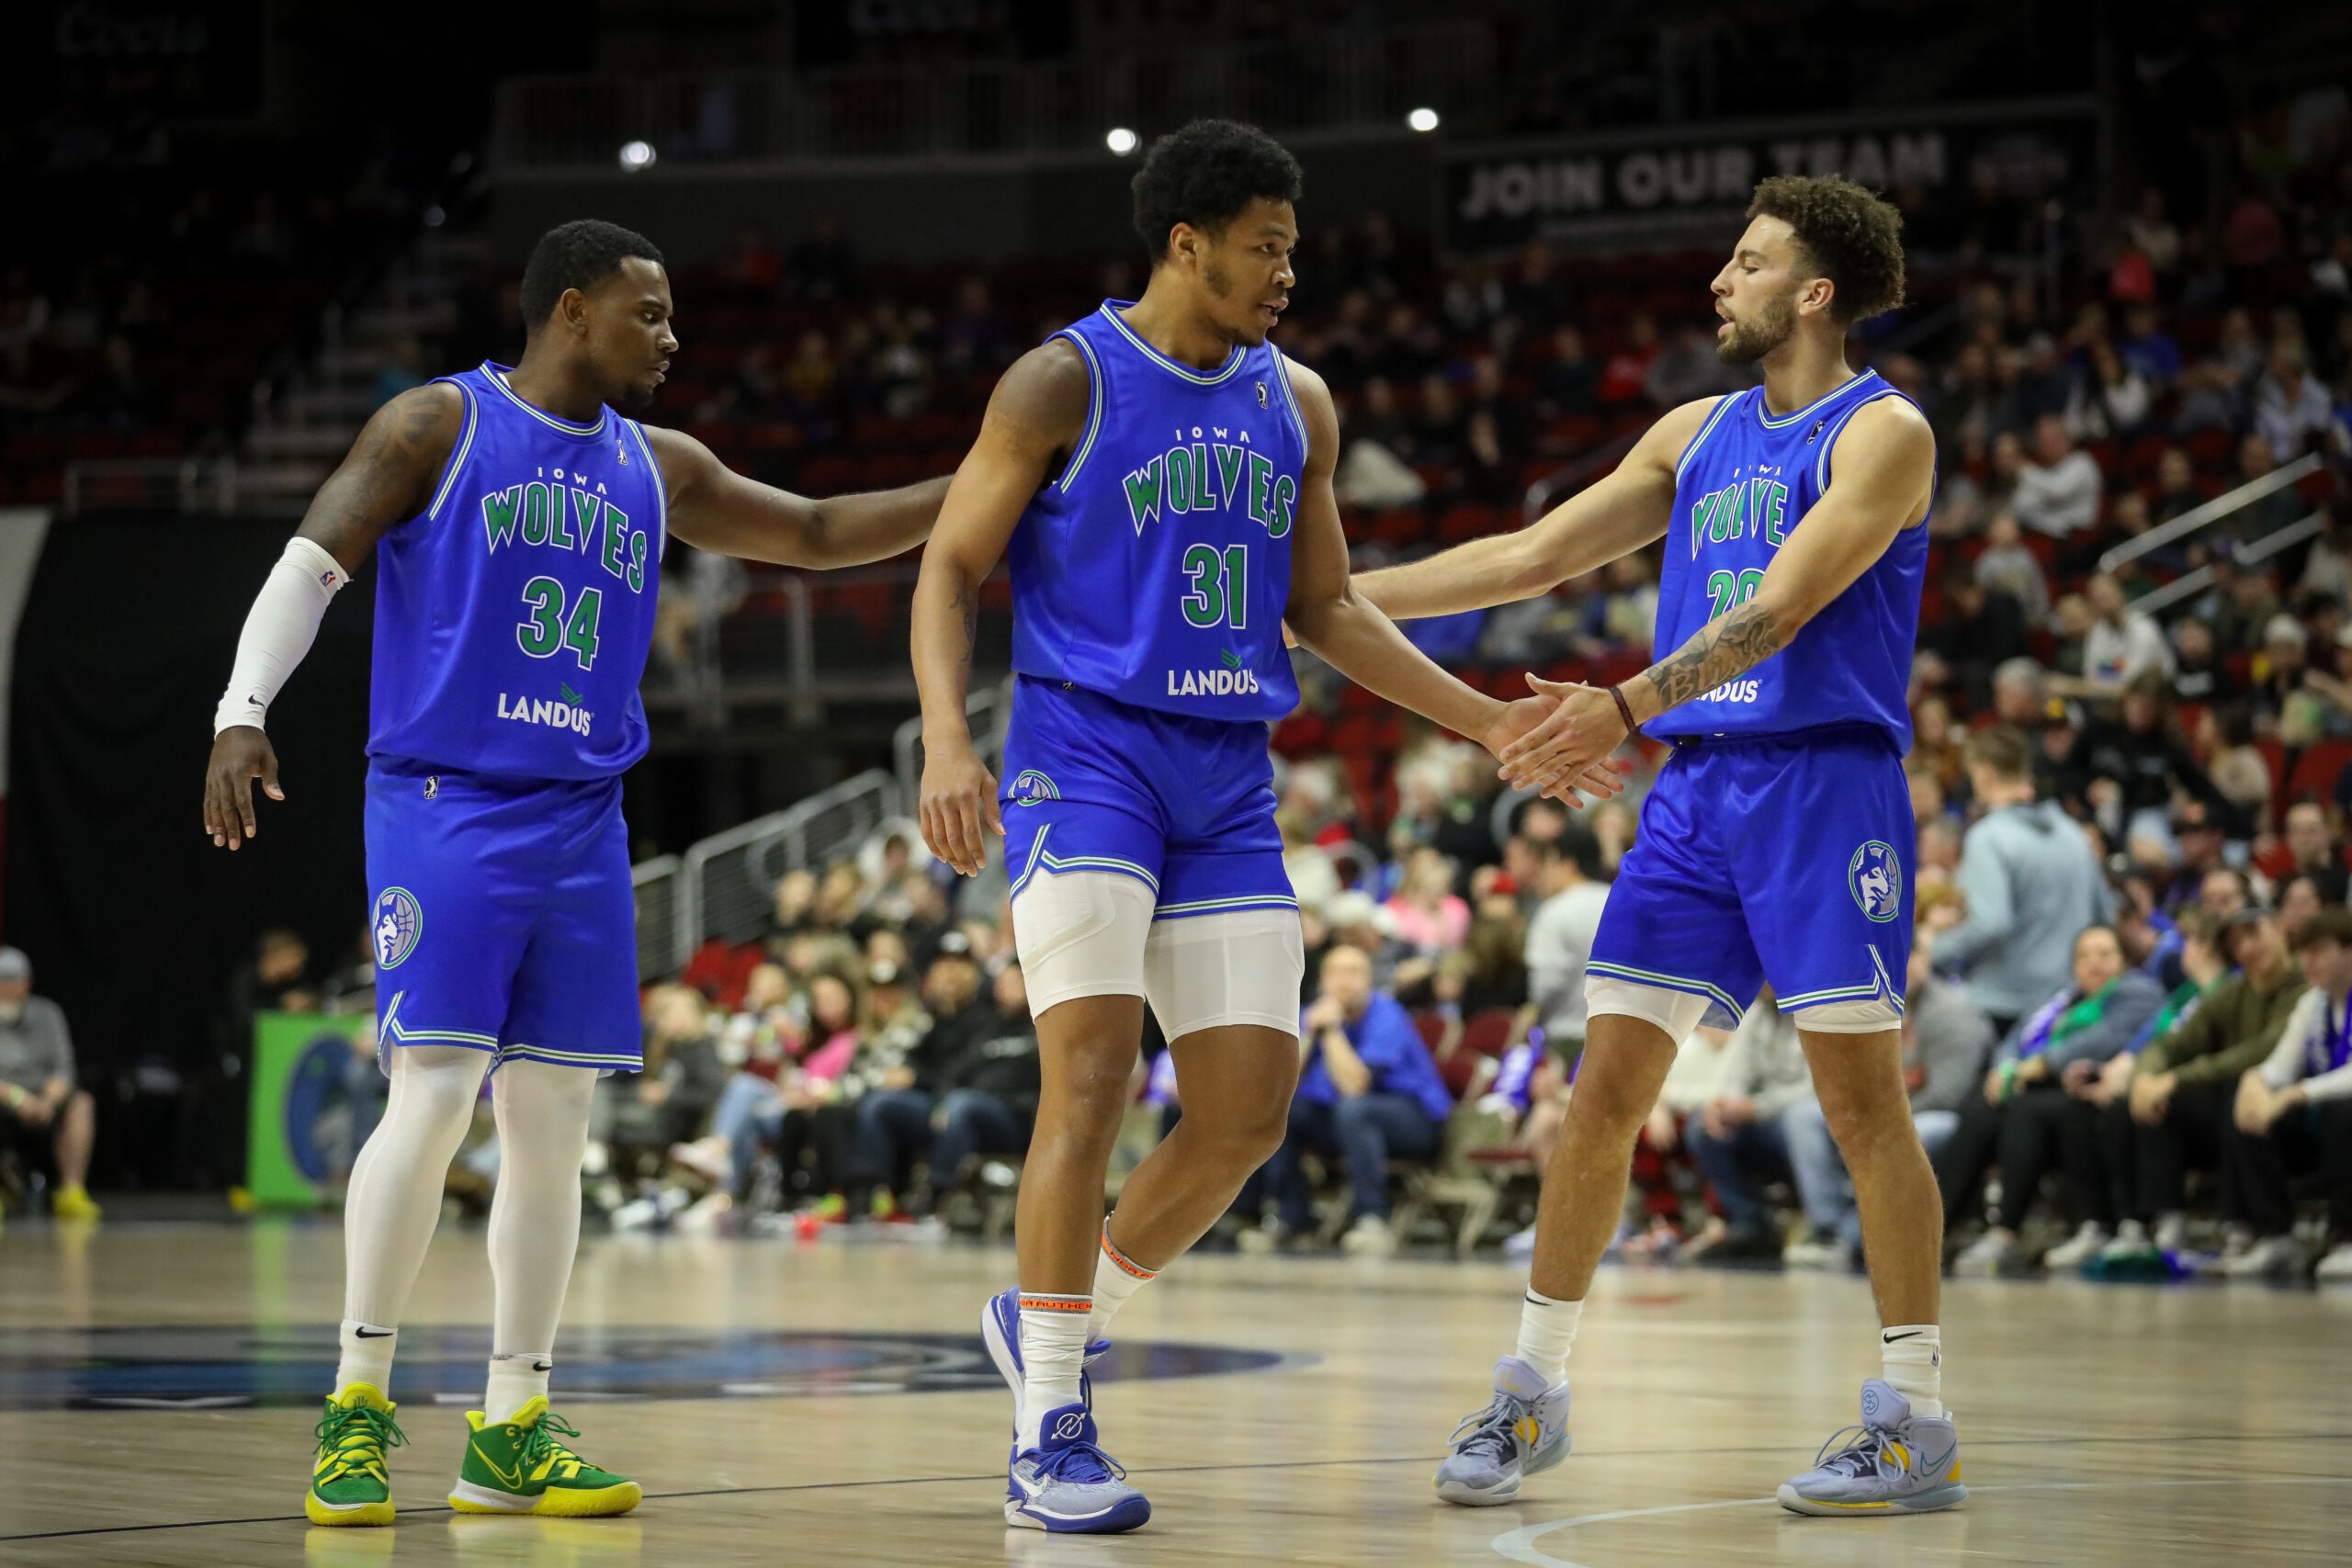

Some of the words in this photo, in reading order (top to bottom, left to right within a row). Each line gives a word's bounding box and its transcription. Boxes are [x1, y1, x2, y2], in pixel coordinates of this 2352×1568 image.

[1459, 158, 1602, 221] JOIN
[1615, 144, 1755, 208] OUR
[1766, 130, 1945, 184] TEAM
[1175, 426, 1250, 443] IOWA
[537, 467, 607, 494] IOWA
[1122, 443, 1296, 539] WOLVES
[481, 481, 648, 594] WOLVES
[1692, 477, 1789, 562] WOLVE
[1181, 543, 1249, 629] 31
[1707, 568, 1766, 625] 20
[516, 575, 603, 671] 34
[497, 692, 592, 738] LANDUS
[1168, 669, 1260, 696] LANDUS
[1695, 680, 1758, 704] NDUS
